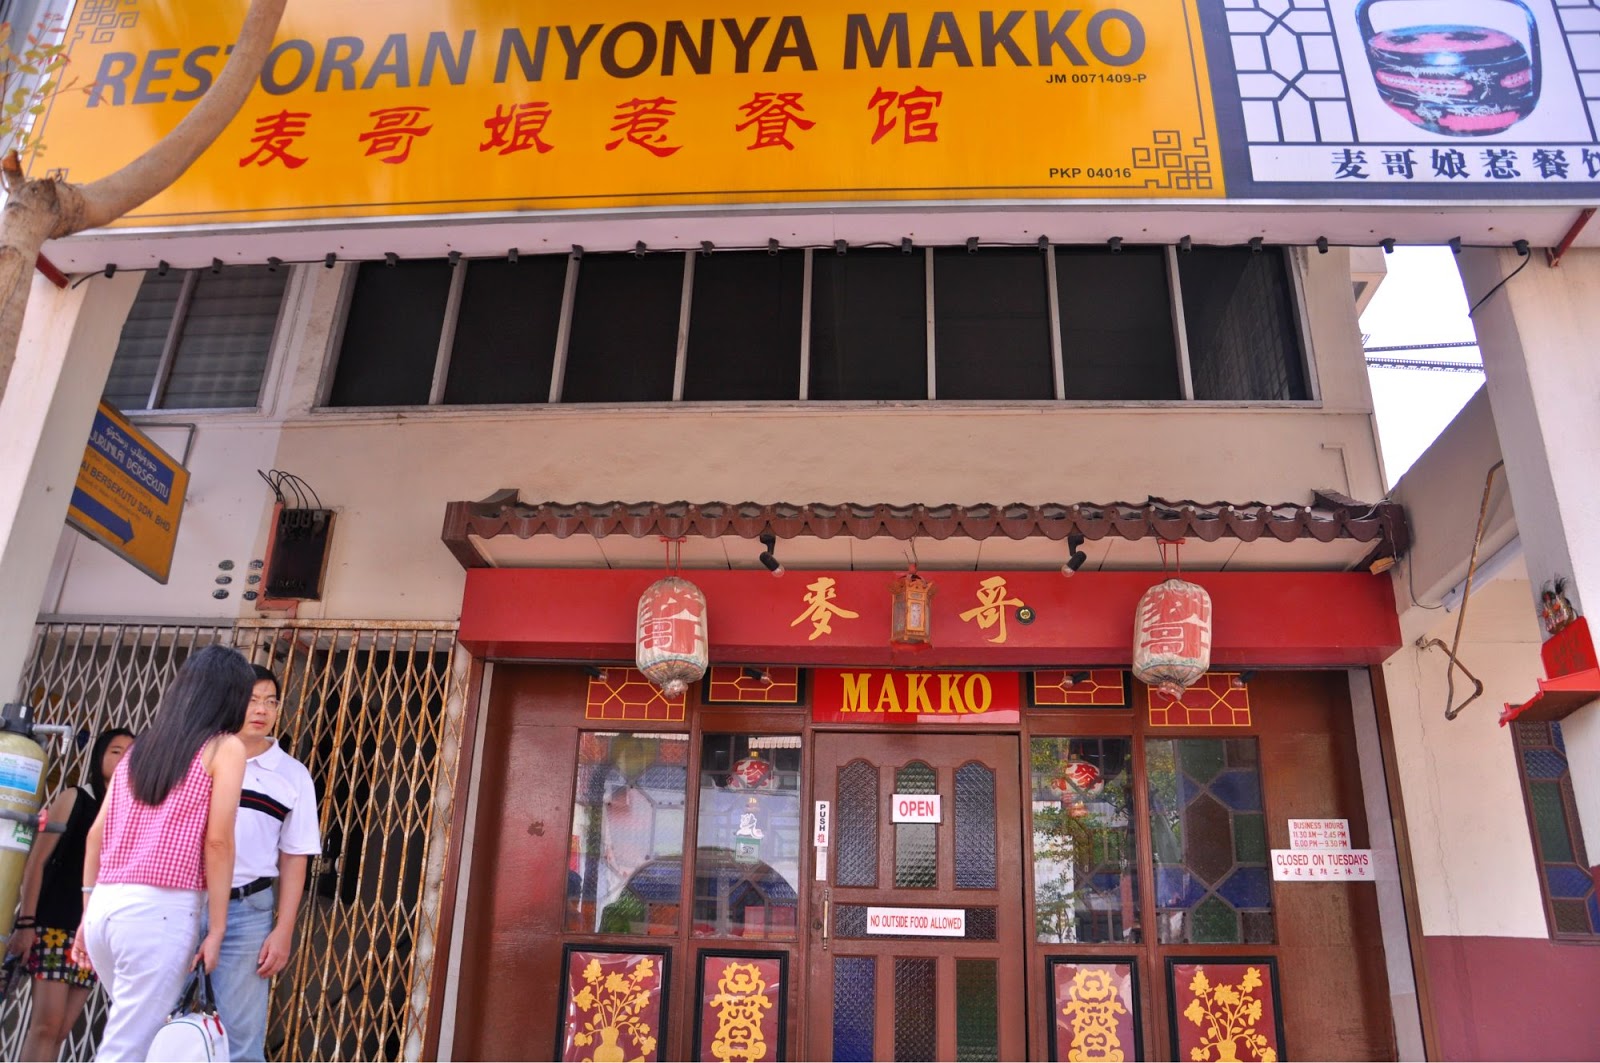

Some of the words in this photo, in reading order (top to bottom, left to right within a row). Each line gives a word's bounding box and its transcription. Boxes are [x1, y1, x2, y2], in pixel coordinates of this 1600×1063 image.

[85, 31, 475, 108] RESORAN
[494, 18, 818, 82] NYONYA
[843, 10, 1147, 69] MAKKO
[1045, 73, 1067, 84] JM
[1071, 73, 1147, 84] 0071409-P
[1049, 167, 1082, 178] PKP
[1086, 167, 1132, 178] 04016
[89, 465, 138, 508] BERSEKUTU
[840, 673, 992, 714] MAKKO
[899, 800, 935, 817] OPEN
[1293, 821, 1322, 830] BUSINESS
[1324, 821, 1344, 830] HOURS
[1337, 831, 1347, 839] PM
[1338, 840, 1348, 848] PM
[1276, 854, 1309, 866] CLOSED
[1312, 854, 1325, 866] ON
[1327, 854, 1369, 866] TUESDAYS
[869, 914, 881, 928] NO
[881, 915, 909, 928] OUTSIDE
[909, 916, 929, 929] FOOD
[929, 917, 963, 930] ALLOWED
